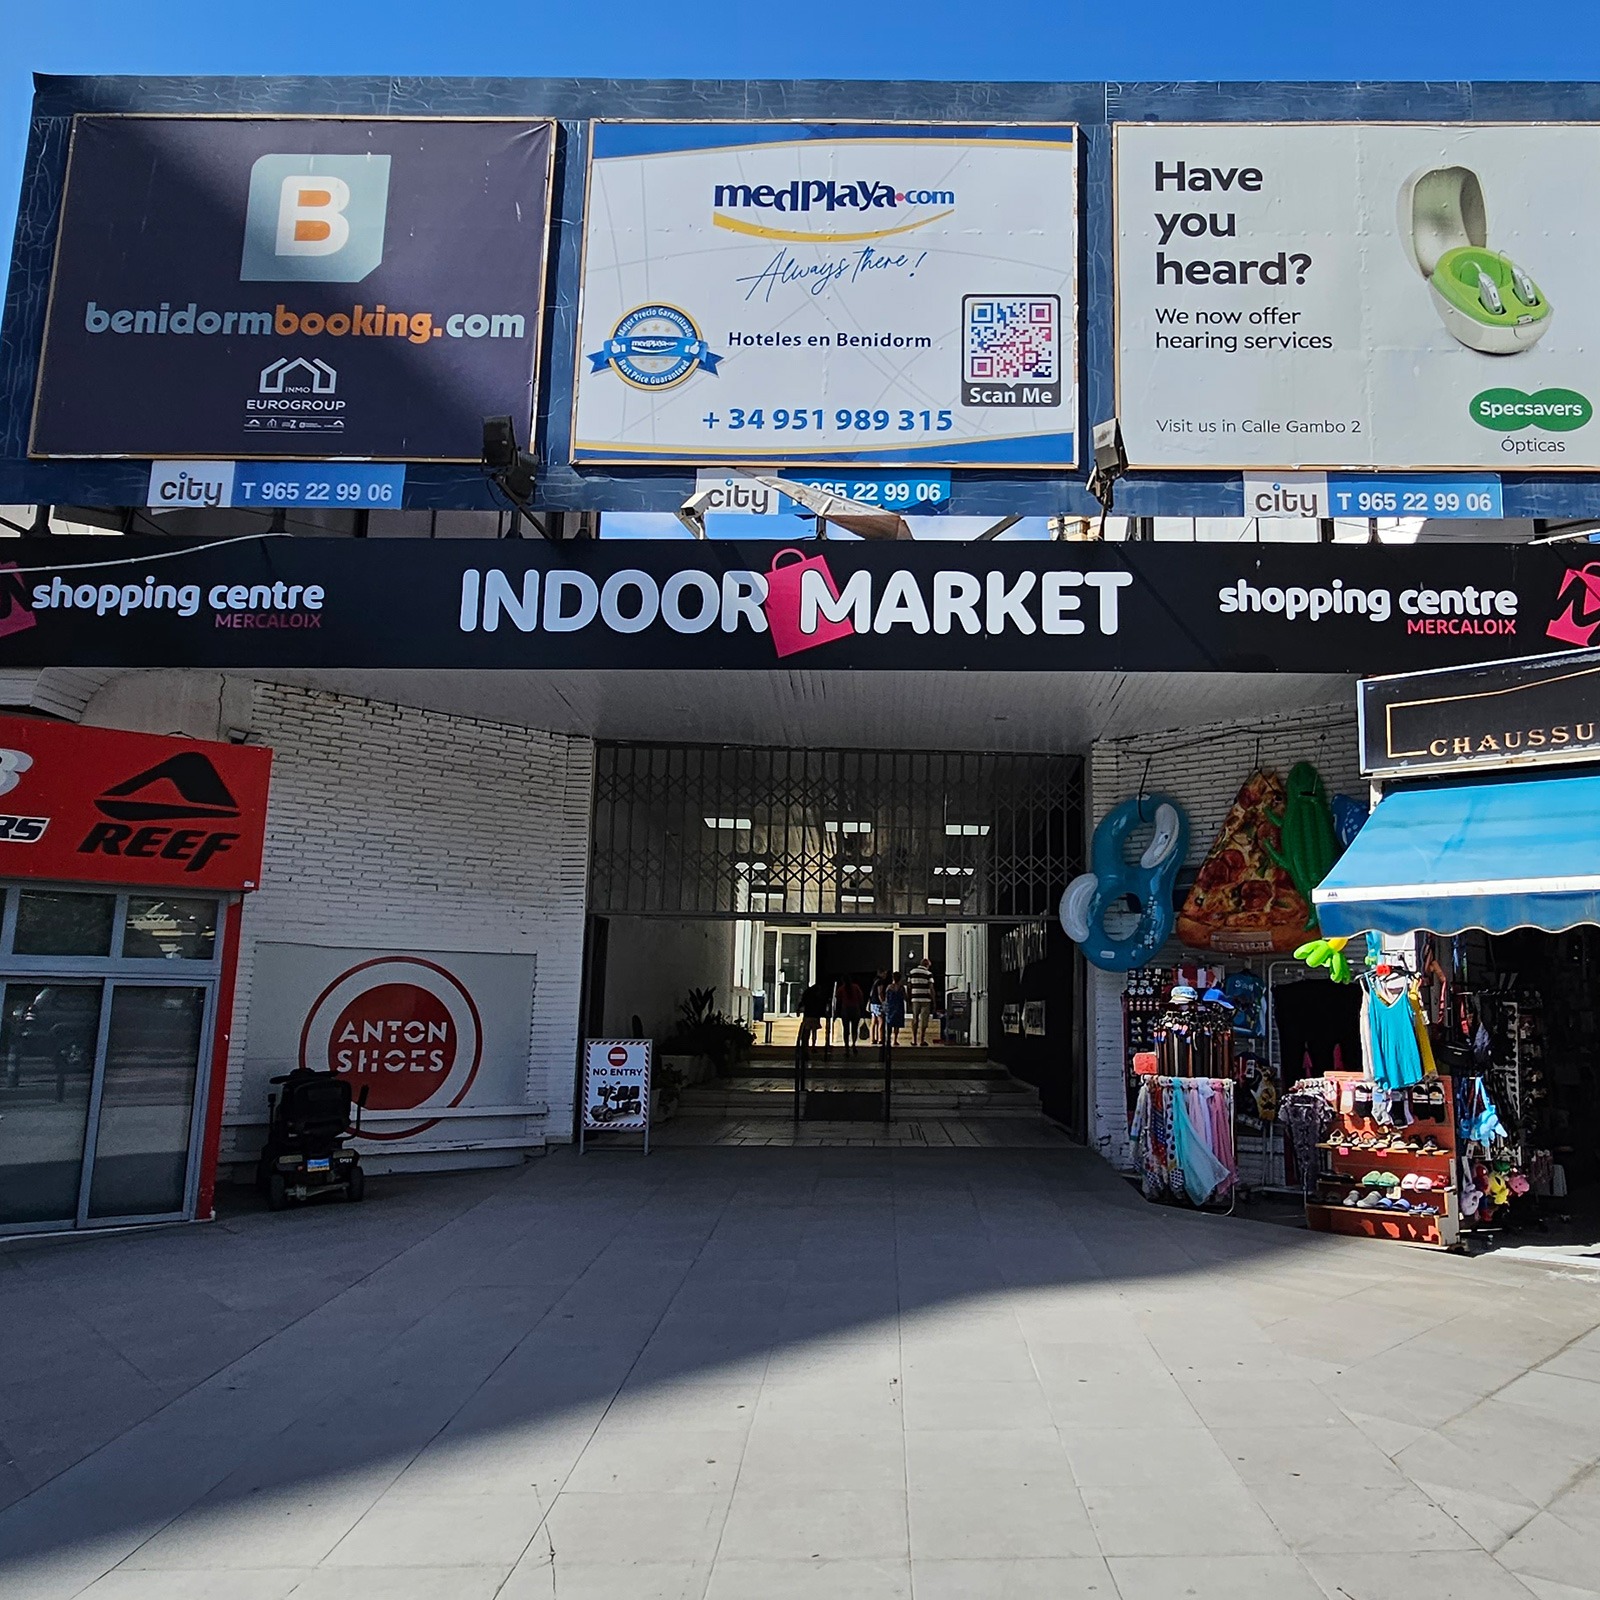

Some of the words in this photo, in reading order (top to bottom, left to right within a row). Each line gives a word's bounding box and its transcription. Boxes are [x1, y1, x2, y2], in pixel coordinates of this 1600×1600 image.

[1154, 160, 1263, 192] Have
[1154, 212, 1237, 245] you
[735, 247, 850, 302] Always
[1155, 251, 1313, 286] heard?
[85, 301, 525, 343] benidormbooking.com
[634, 308, 657, 321] Precio
[658, 308, 693, 338] Garantizado
[1155, 307, 1189, 325] We
[1196, 310, 1243, 325] now
[1249, 306, 1302, 325] offer
[728, 331, 801, 347] Hoteles
[807, 335, 830, 347] en
[836, 332, 932, 348] Benidorm
[1156, 331, 1237, 353] hearing
[1244, 331, 1333, 349] services
[617, 358, 631, 377] Best
[630, 372, 649, 384] Price
[285, 386, 311, 394] INMO
[969, 387, 1016, 404] Scan
[1022, 387, 1052, 404] Me
[246, 399, 346, 411] EUROGROUP
[1479, 400, 1583, 419] Specsavers
[728, 408, 765, 430] 34
[772, 408, 824, 431] 951
[835, 409, 890, 431] 989
[897, 409, 953, 432] 315
[1156, 419, 1193, 433] Visit
[1198, 421, 1217, 433] us
[1222, 419, 1236, 433] in
[1241, 419, 1281, 433] Calle
[1286, 419, 1346, 433] Gambo
[1351, 420, 1362, 433] 2
[1501, 435, 1566, 455] Ópticas
[159, 471, 223, 507] city
[242, 482, 256, 499] T
[261, 482, 300, 500] 965
[304, 482, 330, 501] 22
[336, 483, 361, 501] 99
[368, 483, 393, 502] 06
[709, 479, 769, 515] city
[853, 482, 879, 501] 22
[884, 483, 910, 501] 99
[915, 483, 941, 502] 06
[1255, 483, 1318, 517] city
[1336, 492, 1352, 511] T
[1358, 492, 1397, 512] 965
[1402, 492, 1428, 512] 22
[1434, 492, 1460, 512] 99
[1466, 493, 1492, 513] 06
[31, 575, 200, 617] shopping
[208, 581, 325, 610] centre
[459, 568, 769, 634] INDOOR
[800, 569, 1134, 635] MARKET
[1218, 578, 1391, 622] shopping
[1399, 585, 1518, 616] centre
[214, 613, 323, 629] MERCALOIX
[1407, 618, 1516, 635] MERCALOIX
[1429, 722, 1595, 757] CHAUSSU
[76, 822, 241, 873] REEF
[338, 1020, 448, 1044] ANTON
[336, 1049, 444, 1073] SHOES
[592, 1068, 608, 1076] NO
[610, 1068, 643, 1076] ENTRY
